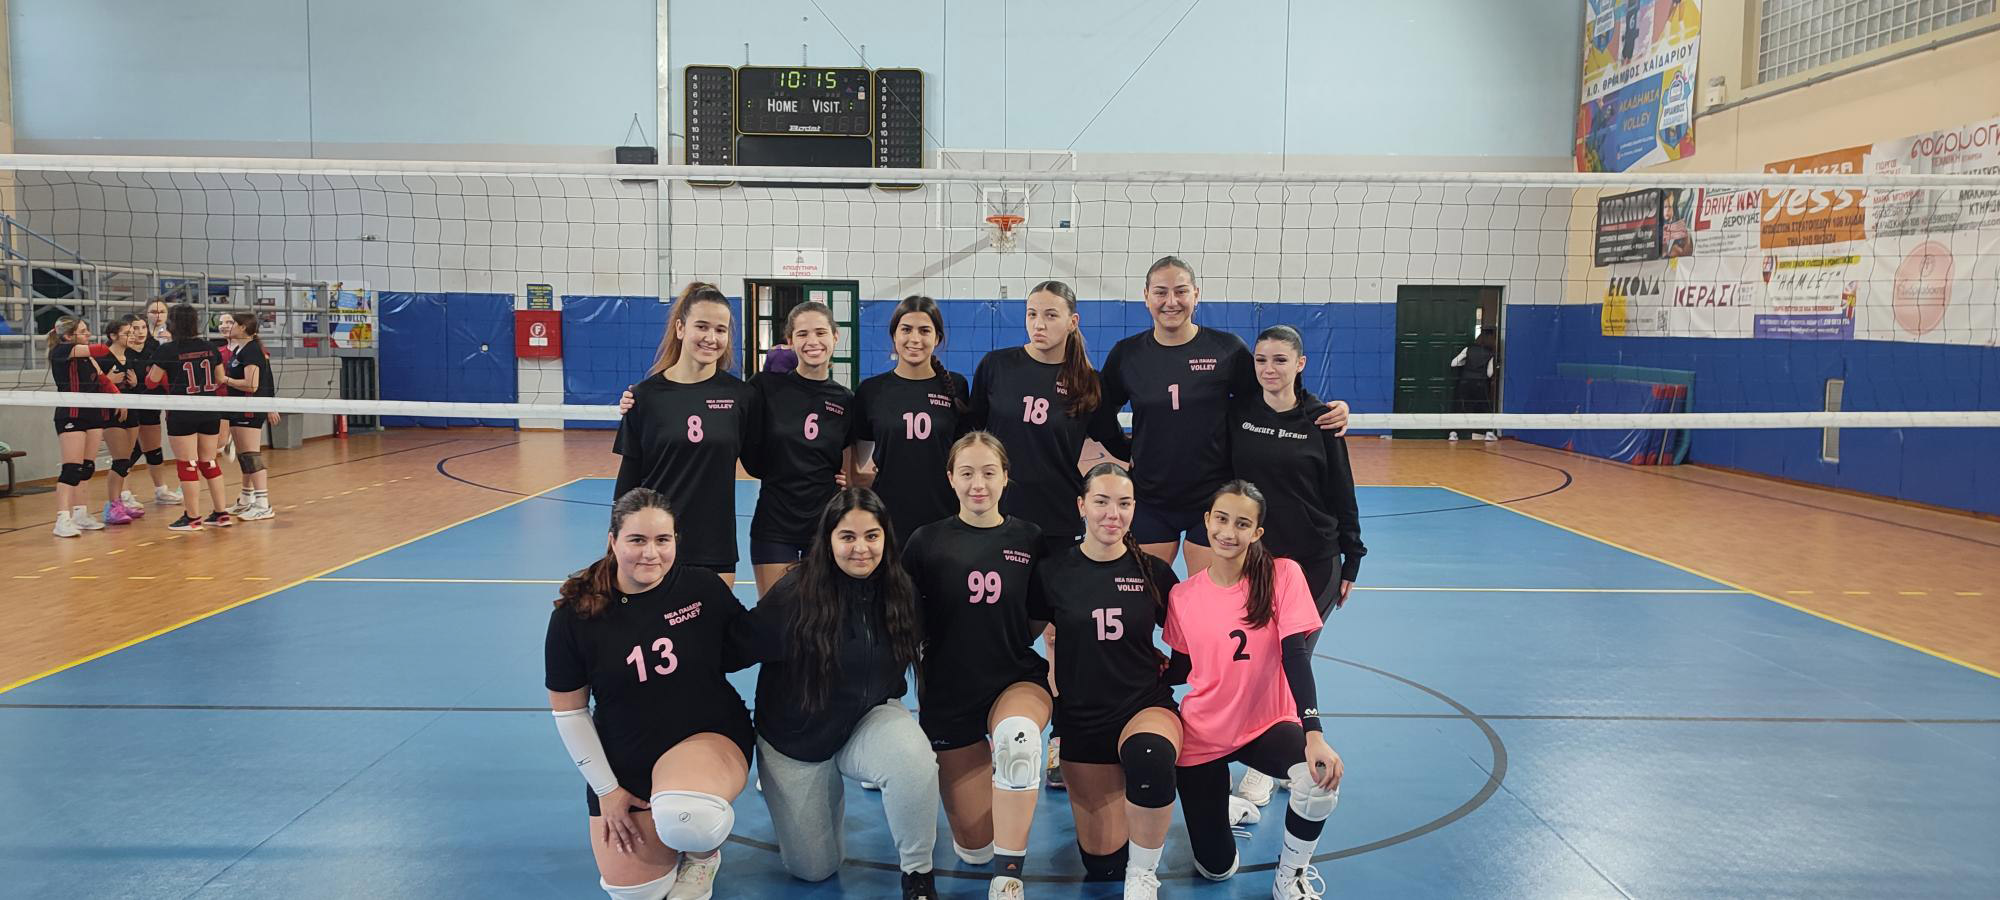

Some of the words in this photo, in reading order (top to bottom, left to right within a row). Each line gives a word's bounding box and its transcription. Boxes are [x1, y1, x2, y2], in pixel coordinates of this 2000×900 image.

[780, 71, 836, 88] 10:15
[767, 98, 798, 112] HOME
[1704, 195, 1733, 216] DRIVE
[1736, 190, 1761, 211] WAY
[183, 359, 218, 394] 11
[825, 406, 844, 415] VOLLEY
[930, 399, 951, 408] VOLLEY
[1023, 395, 1049, 425] 18
[1168, 384, 1180, 411] 1
[687, 415, 704, 443] 8
[804, 413, 819, 440] 6
[902, 412, 932, 440] 10
[1242, 421, 1275, 436] Obscure
[1278, 428, 1308, 440] Person
[1005, 555, 1030, 565] VOLLEY
[967, 570, 1002, 604] 99
[1117, 584, 1144, 592] VOLLEY
[1091, 608, 1124, 641] 15
[1229, 629, 1250, 662] 2
[626, 637, 678, 682] 13
